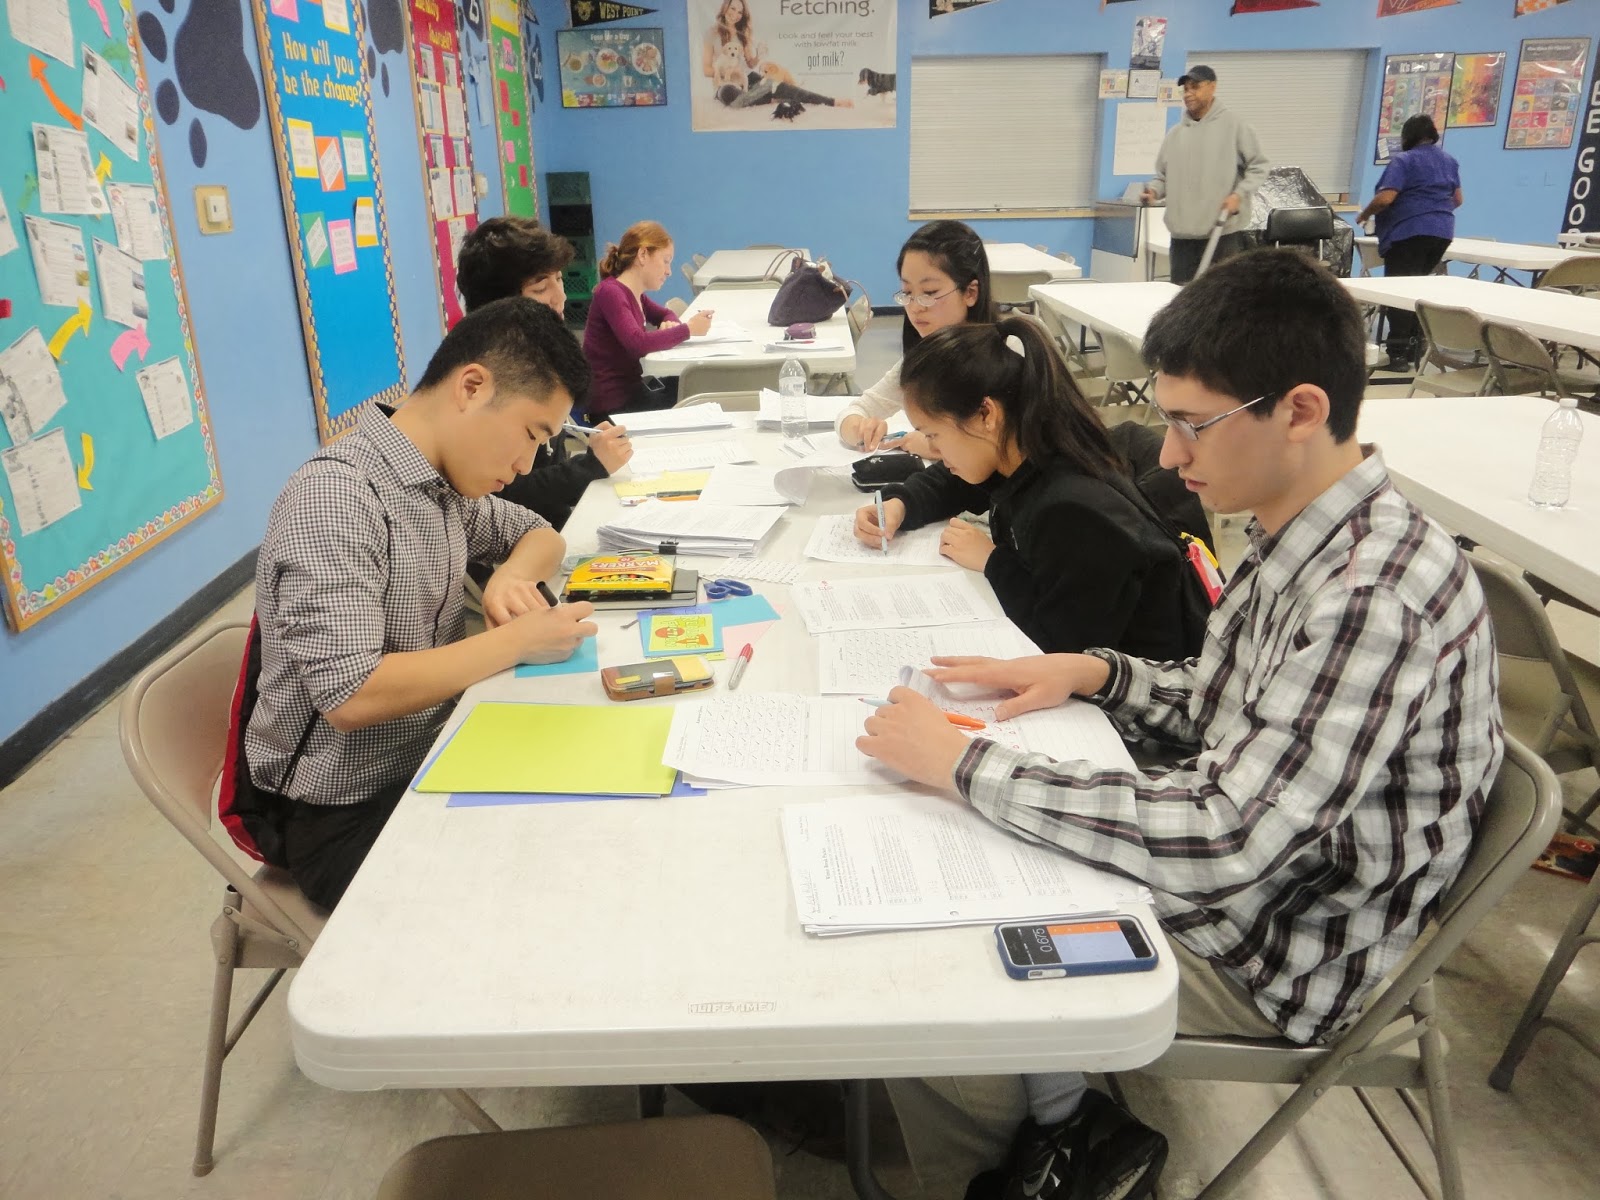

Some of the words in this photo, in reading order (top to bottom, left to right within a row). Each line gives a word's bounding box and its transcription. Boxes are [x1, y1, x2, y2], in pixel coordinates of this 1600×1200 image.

[599, 2, 620, 19] WEST
[622, 6, 644, 17] POINT
[780, 0, 875, 17] Fetching.
[794, 40, 812, 48] with
[814, 40, 839, 48] lowfat
[835, 32, 854, 41] your
[282, 32, 307, 62] How
[311, 40, 330, 66] will
[334, 55, 355, 79] you
[807, 52, 820, 70] got
[822, 51, 845, 67] milk?
[282, 66, 299, 96] be
[301, 69, 320, 96] the
[323, 73, 363, 107] change?
[591, 560, 659, 569] MARKERS
[1032, 928, 1053, 953] 0.675
[697, 1001, 768, 1013] LIFETIME
